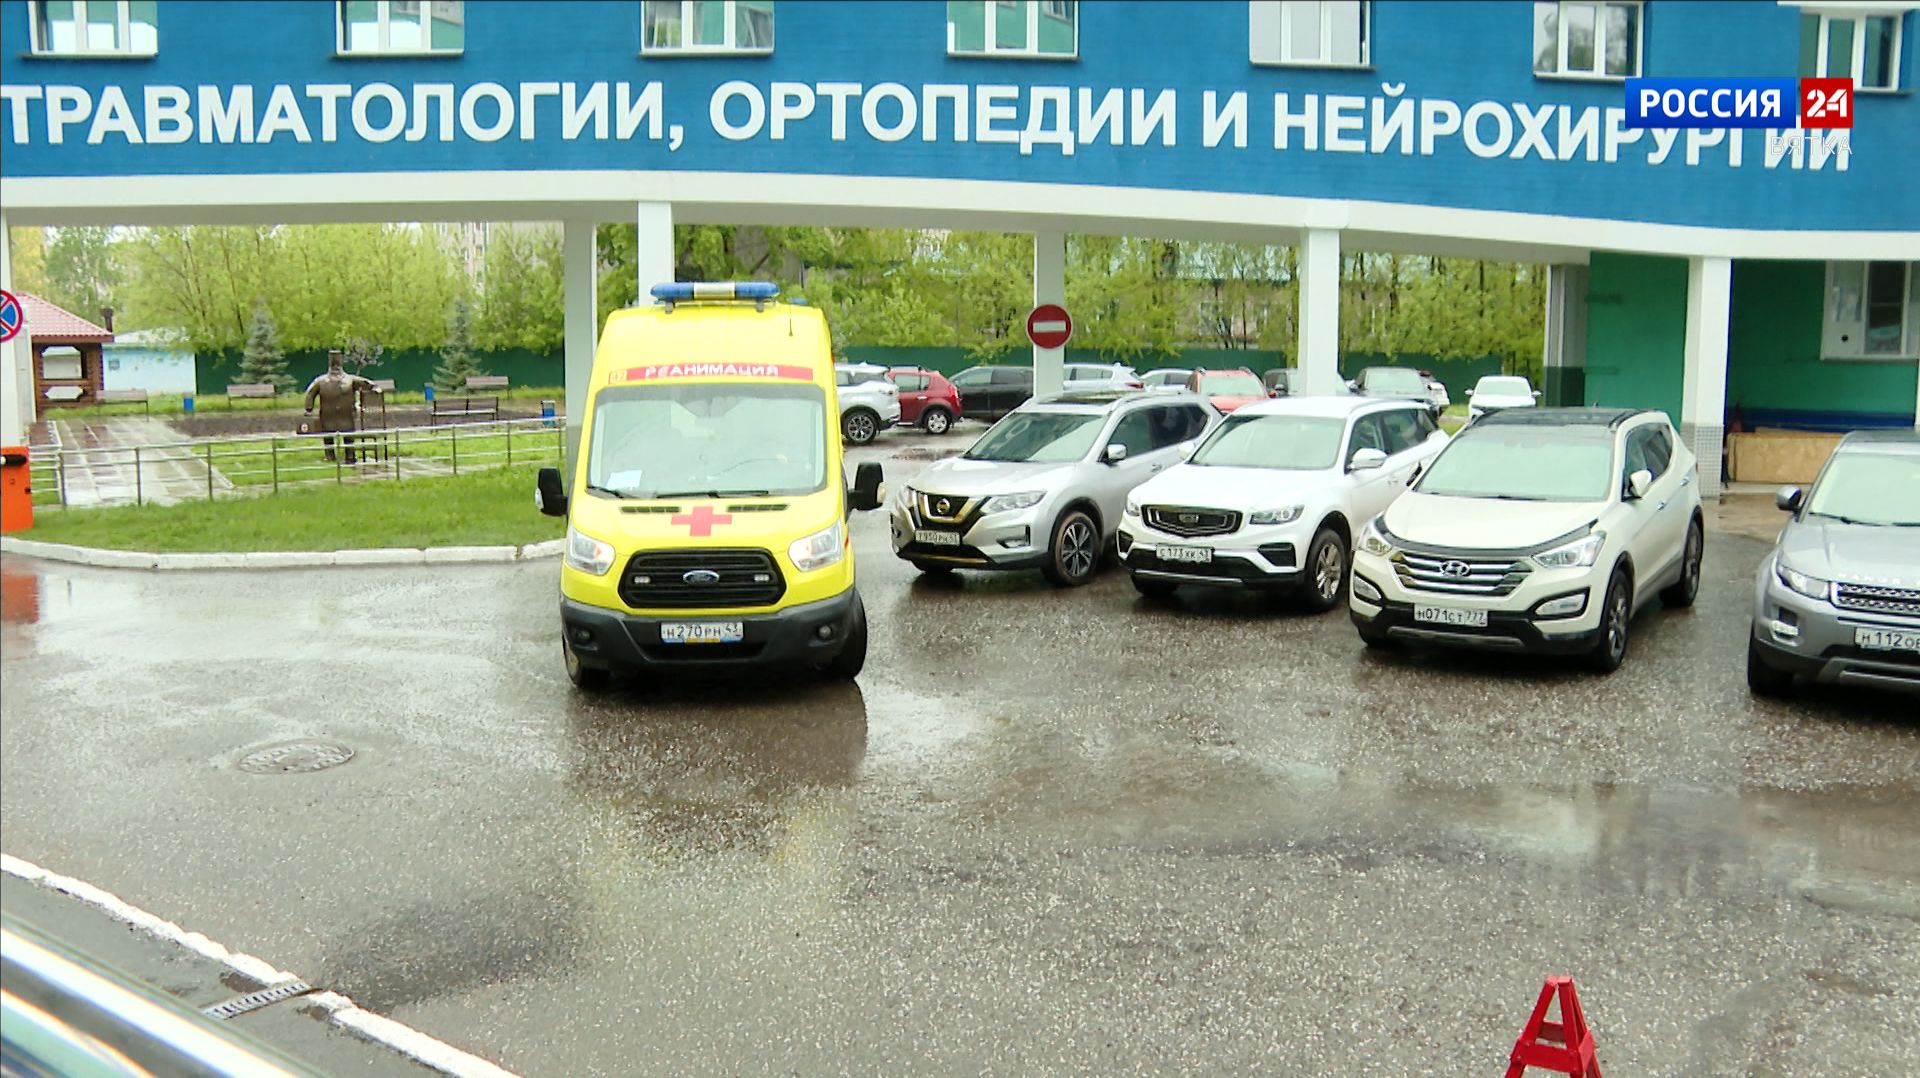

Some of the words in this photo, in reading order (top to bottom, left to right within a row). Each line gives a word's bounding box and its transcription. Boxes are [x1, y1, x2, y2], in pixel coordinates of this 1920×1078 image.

[1, 81, 684, 151] ТРАВМАТОЛОГИИ,
[709, 81, 1176, 155] ОРТОПЕДИИ
[1202, 90, 1248, 148] И
[645, 363, 779, 377] РЕАНИМАЦИЯ
